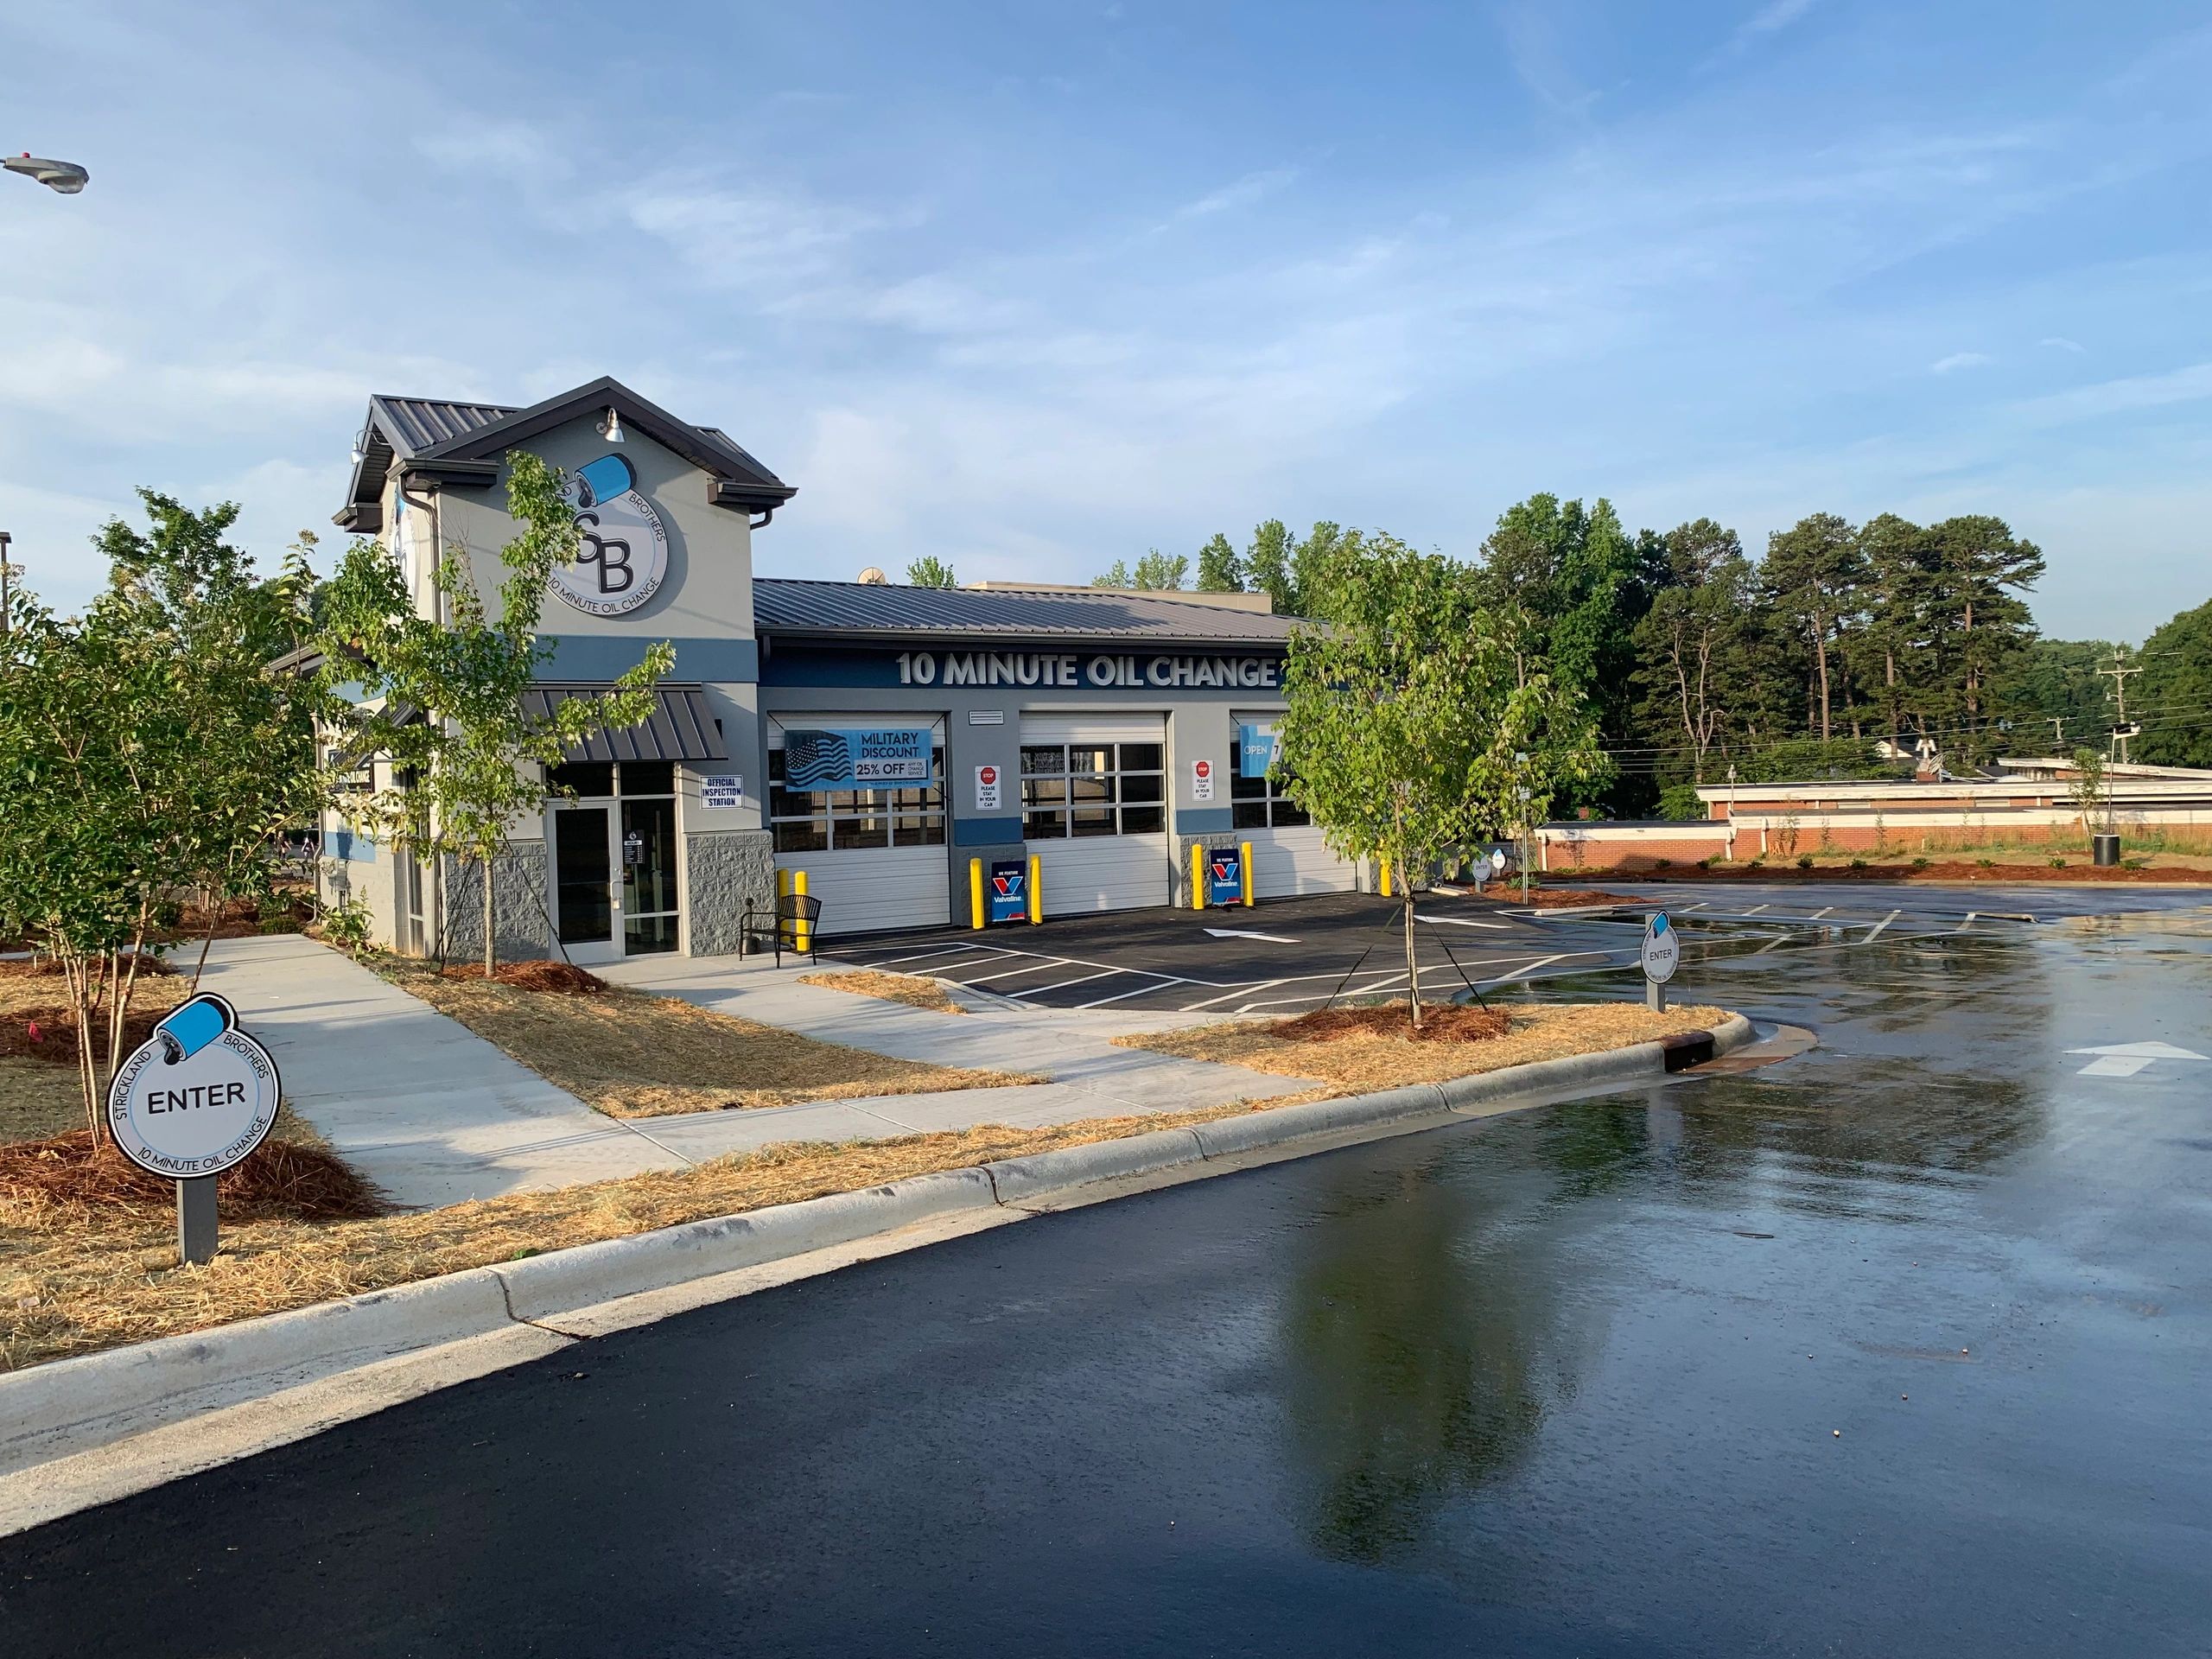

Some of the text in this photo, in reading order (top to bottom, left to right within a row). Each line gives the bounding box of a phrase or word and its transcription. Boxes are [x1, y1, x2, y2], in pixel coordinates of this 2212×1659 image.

[629, 493, 665, 542] BROTHERS
[549, 576, 659, 613] 10 MINUTE OIL CHANGE
[896, 652, 1277, 687] 10 MINUTE OIL CHANGE
[861, 733, 918, 745] MILITARY
[1244, 745, 1279, 755] OPEN 7
[861, 747, 919, 759] DISCOUNT
[856, 763, 906, 775] 25% OFF
[702, 788, 741, 797] INSPECTION
[709, 798, 735, 806] STATION
[1649, 949, 1673, 961] ENTER
[223, 1034, 269, 1079] BROTHERS
[115, 1051, 151, 1121] STRICKLAND
[148, 1082, 246, 1115] ENTER
[137, 1116, 267, 1172] 10 MINUTE OIL CHANGE
